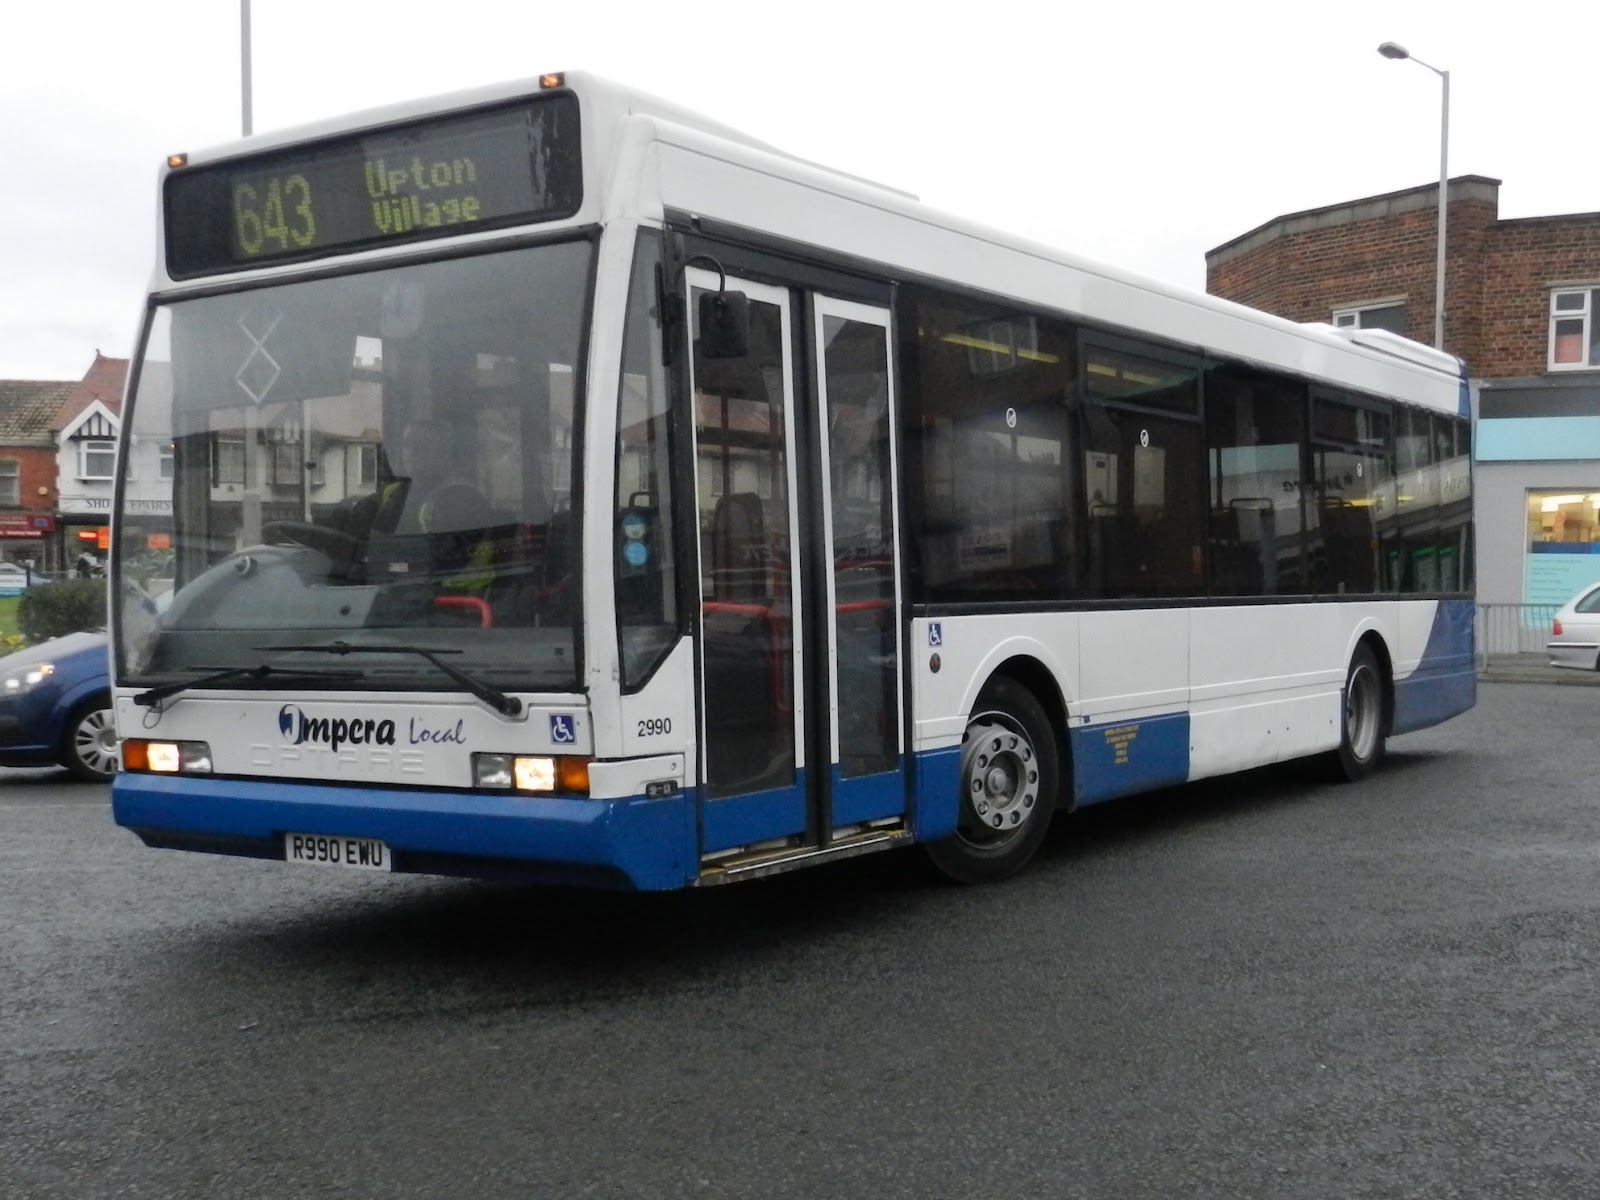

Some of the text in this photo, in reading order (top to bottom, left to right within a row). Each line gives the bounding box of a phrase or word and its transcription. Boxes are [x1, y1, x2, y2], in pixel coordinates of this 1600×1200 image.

[364, 157, 476, 198] Upton
[235, 174, 316, 254] 643
[371, 196, 480, 234] Village
[86, 499, 171, 511] SHO EPAIRS
[278, 703, 467, 752] Impera Local
[637, 717, 672, 737] 2990
[293, 836, 383, 867] R990 EWU
